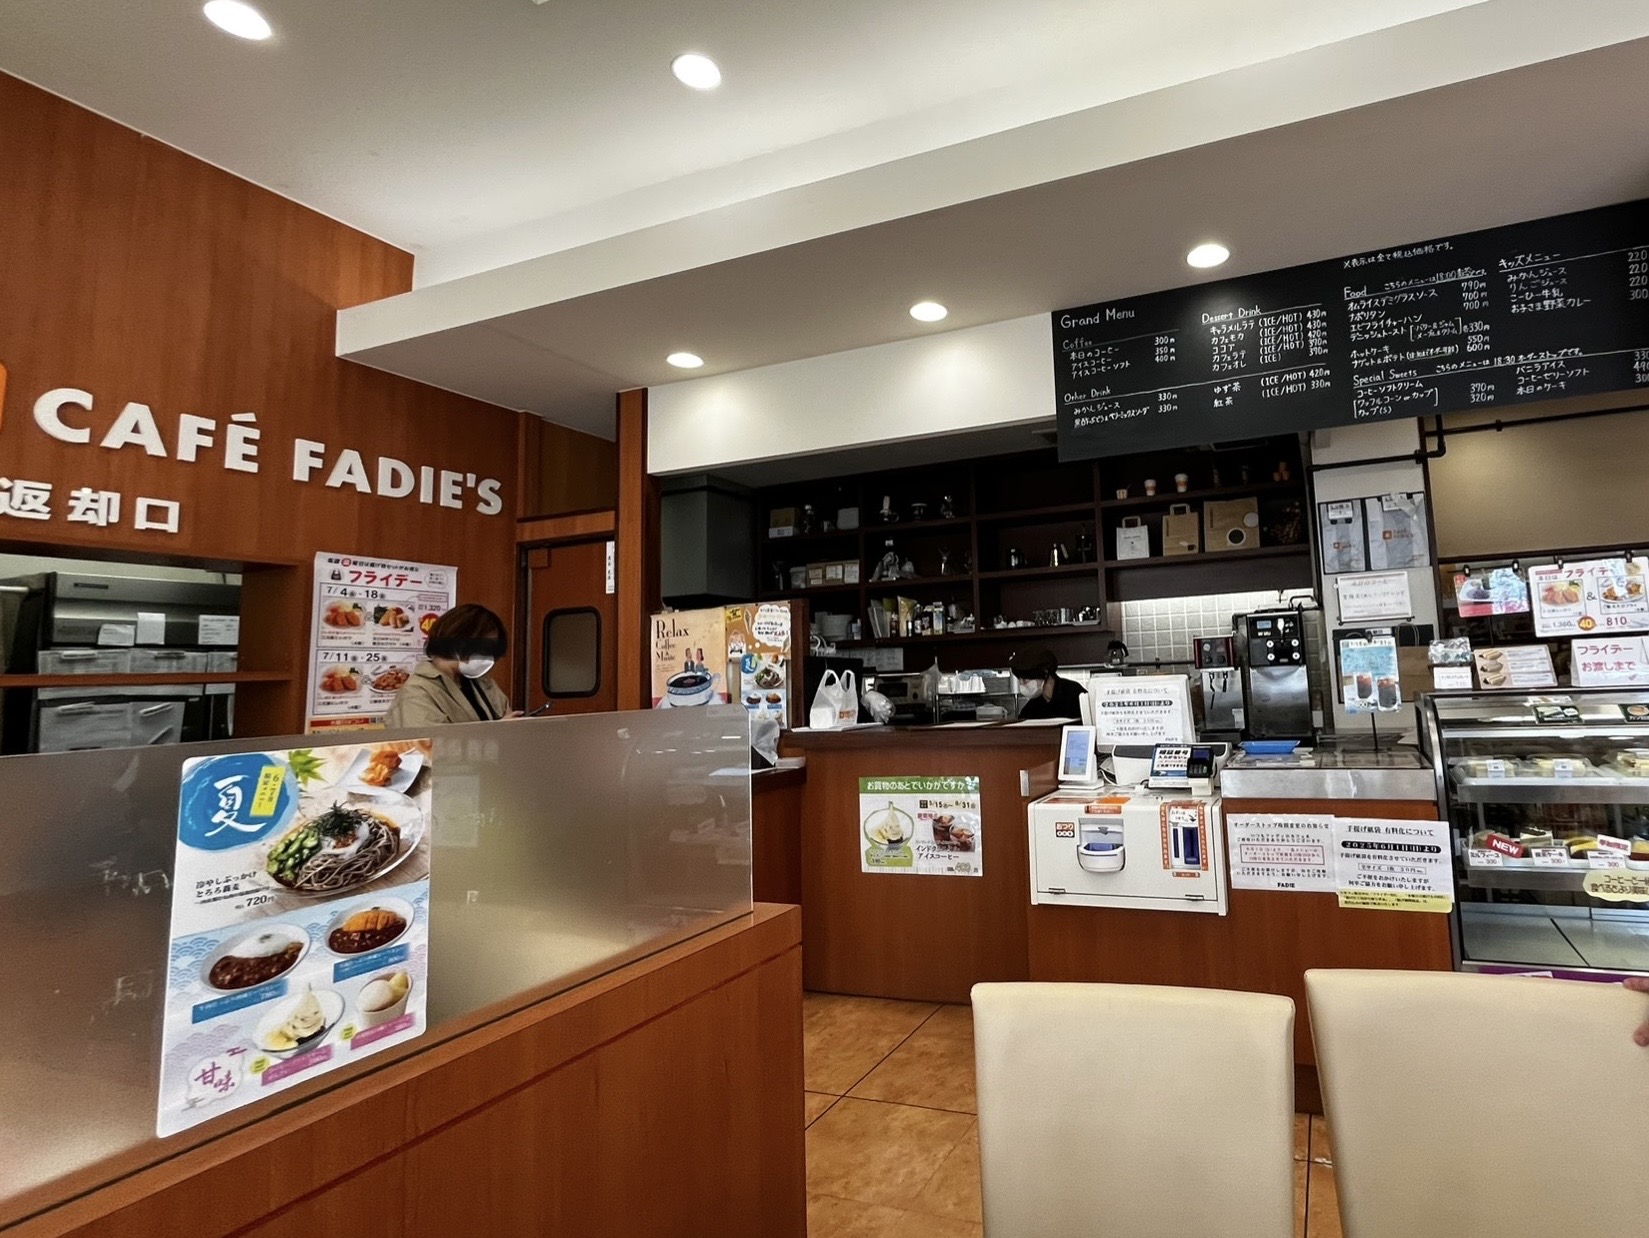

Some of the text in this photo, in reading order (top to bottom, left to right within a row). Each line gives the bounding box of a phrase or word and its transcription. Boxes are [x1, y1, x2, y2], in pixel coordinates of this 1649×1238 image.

[1498, 253, 1560, 269] キッズメニュー
[1507, 267, 1567, 283] みかんジュース
[1344, 285, 1367, 299] Food
[1509, 278, 1568, 293] りんごジュース
[1060, 307, 1135, 329] Grand Menu
[1201, 305, 1262, 324] Dessert Drink
[1348, 310, 1386, 322] ナポリタン
[1210, 320, 1255, 335] キャラメルラテ
[1258, 312, 1303, 327] (ICE/HOT)
[1259, 322, 1303, 337] (ICE/HOT)
[1350, 314, 1423, 332] エビフライチャーハン
[1062, 337, 1092, 350] Coffee
[1212, 343, 1235, 354] ココア
[1069, 347, 1119, 360] 本日のコーヒー
[1212, 350, 1246, 363] カフェラテ
[1350, 345, 1390, 359] ホットケーキ
[1071, 358, 1112, 370] アイスコーヒー
[1212, 360, 1247, 371] カフェオレ
[1259, 353, 1281, 364] (ICE)
[1516, 360, 1566, 375] バニラアイス
[1071, 361, 1131, 379] アイスコーヒーソフト
[1517, 368, 1590, 385] コーヒーゼリーソフト
[1353, 369, 1417, 387] Special Sweets
[1064, 385, 1111, 403] Other Drink
[1213, 381, 1241, 394] ゆず茶
[1516, 381, 1567, 396] 本日のケーキ
[1073, 402, 1121, 415] みかんジュース
[1213, 396, 1233, 408] 紅茶
[33, 387, 504, 515] CAFÉ FADIE'S
[349, 570, 422, 587] フライデー
[656, 618, 689, 639] Relax
[1606, 616, 1627, 626] 810
[655, 639, 675, 650] Coffee
[1577, 644, 1634, 656] フライデー
[205, 774, 267, 837] 夏
[1492, 839, 1520, 855] NEW
